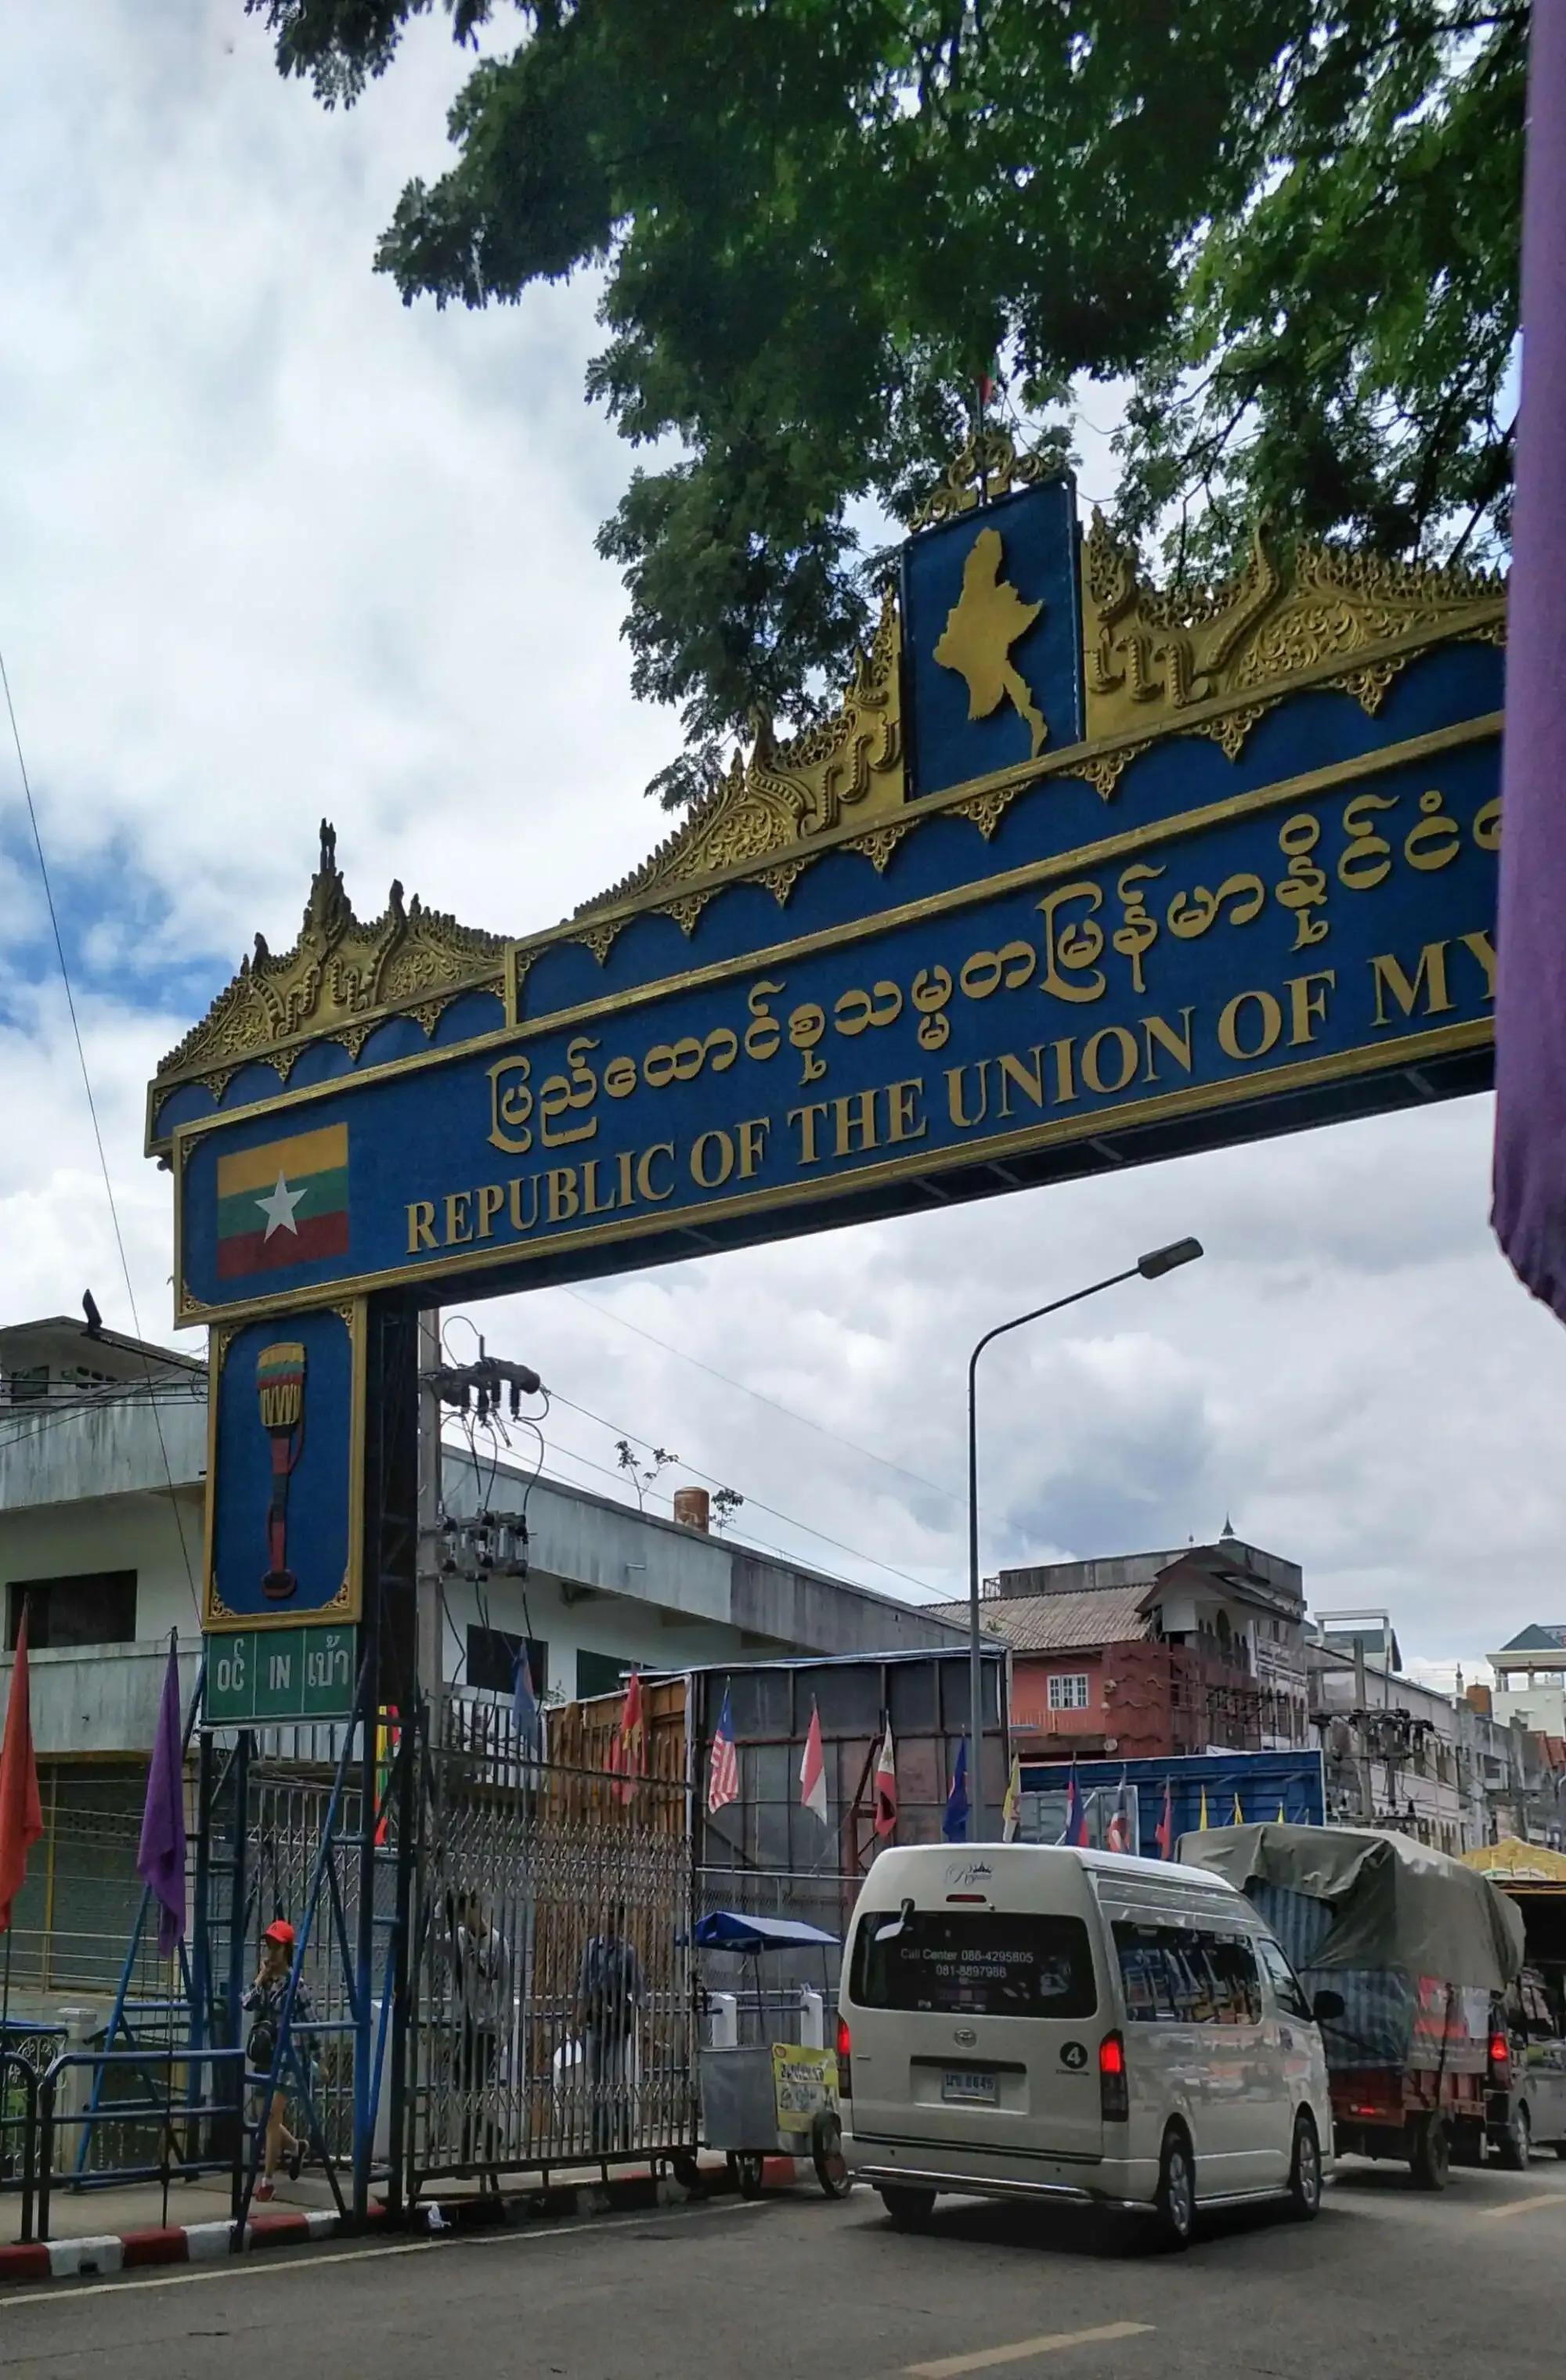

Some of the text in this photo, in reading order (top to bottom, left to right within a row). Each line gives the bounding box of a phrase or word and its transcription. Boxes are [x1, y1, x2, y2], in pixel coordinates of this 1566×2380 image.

[405, 1142, 677, 1254] REPUBLIC
[689, 1116, 771, 1188] OF
[787, 1077, 929, 1166] THE
[942, 1007, 1196, 1127] UNION
[1218, 968, 1336, 1060] OF
[269, 1654, 291, 1690] IN
[309, 1635, 349, 1687] เข้า
[900, 1948, 920, 1960] Call
[922, 1949, 958, 1960] Center
[1066, 2046, 1081, 2065] 4
